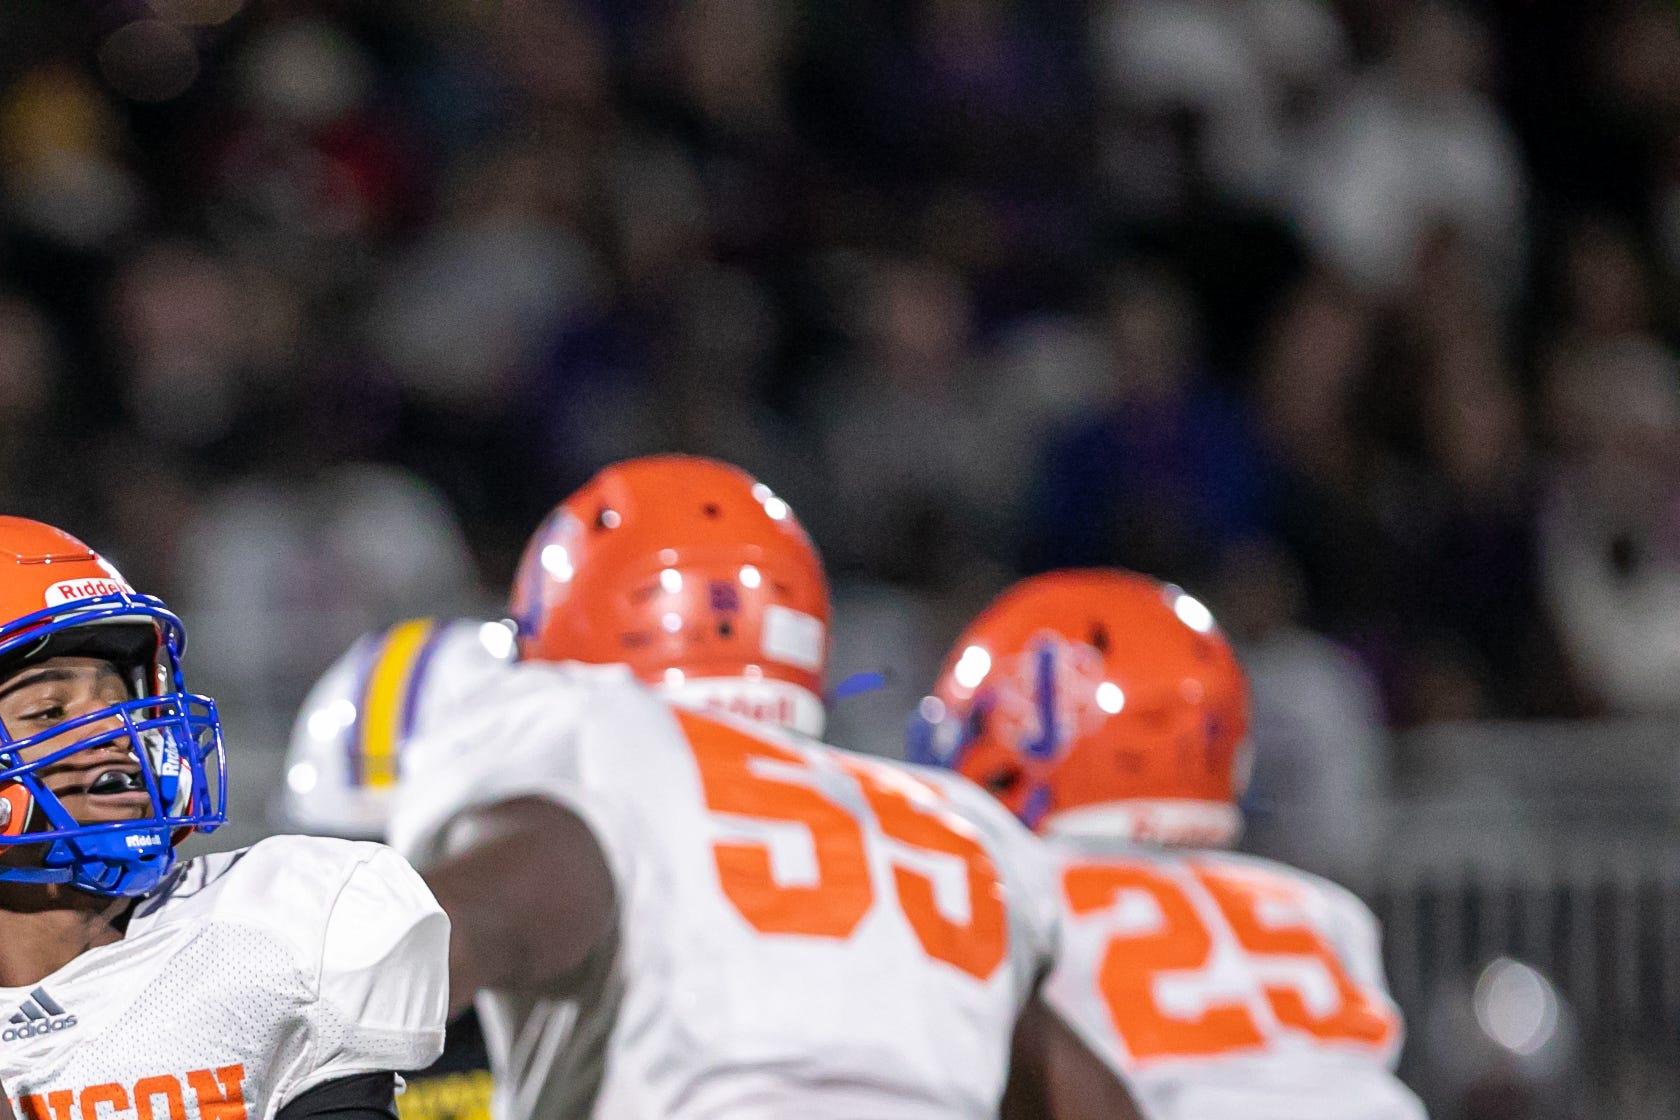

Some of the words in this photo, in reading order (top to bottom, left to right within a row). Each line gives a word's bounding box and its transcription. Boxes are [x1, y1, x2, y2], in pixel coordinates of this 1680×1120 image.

[672, 706, 1010, 985] 55
[2, 1014, 78, 1042] adidas
[1062, 858, 1390, 1060] 25
